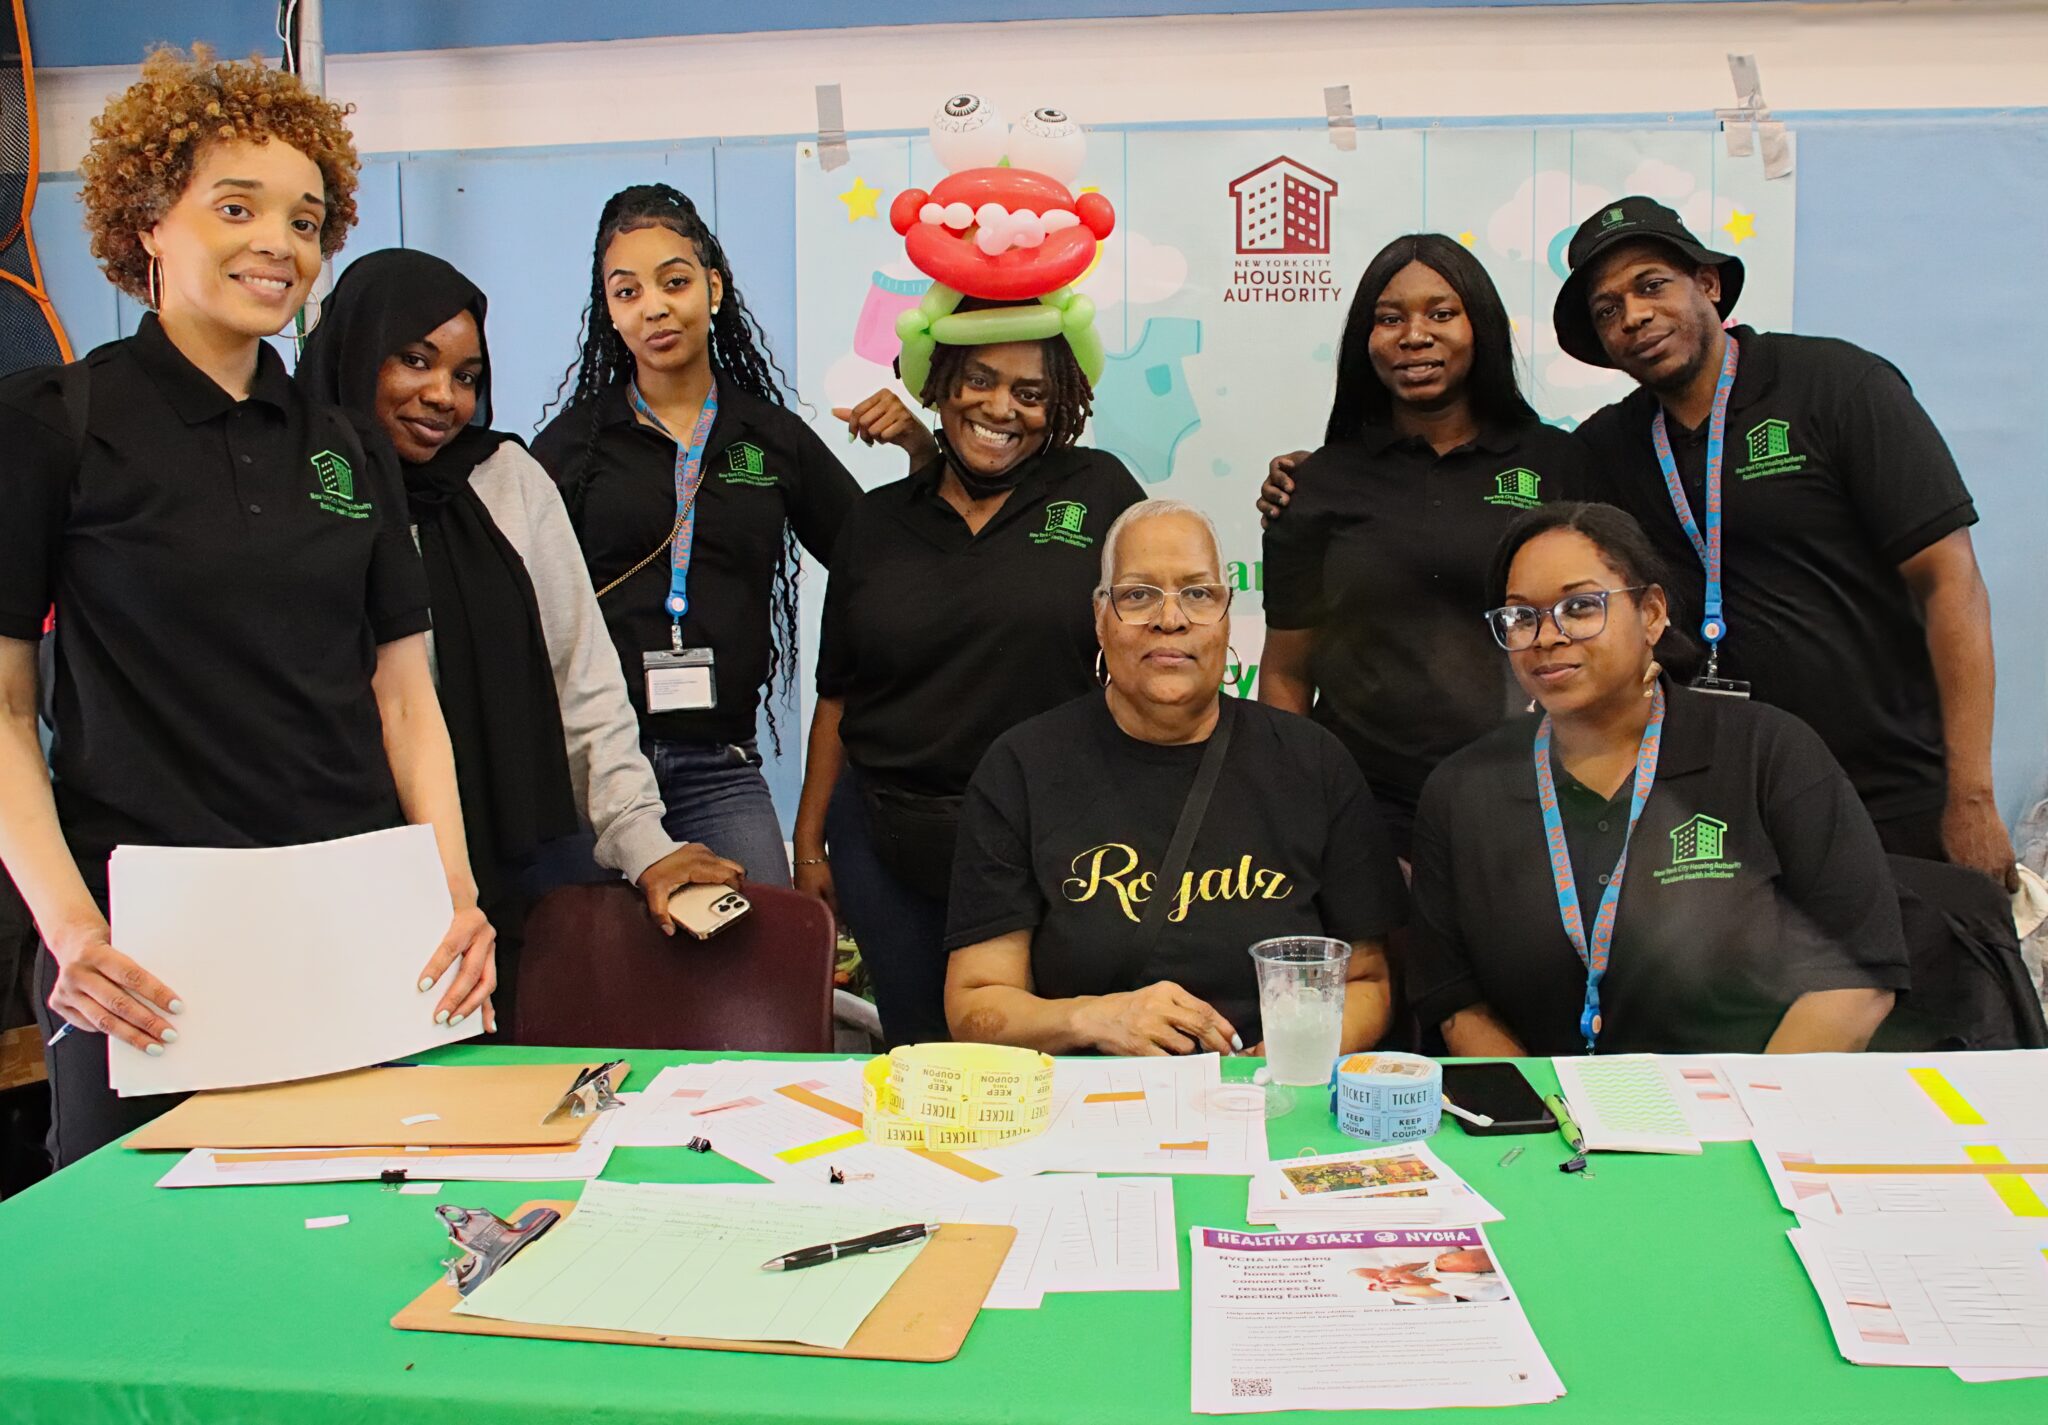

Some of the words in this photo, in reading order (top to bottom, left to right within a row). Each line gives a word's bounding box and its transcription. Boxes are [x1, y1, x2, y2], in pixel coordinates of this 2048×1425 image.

[1235, 259, 1261, 267] NEW
[1266, 259, 1298, 267] YORK
[1303, 259, 1331, 267] CITY
[1234, 270, 1332, 285] HOUSING
[1223, 288, 1341, 302] AUTHORITY
[1711, 385, 1732, 440] NYCHA
[694, 408, 715, 446] NYCHA
[1708, 455, 1722, 513] NYCHA
[1667, 471, 1690, 525] NYCHA
[675, 519, 692, 570] NYCHA
[1709, 526, 1721, 582] NYCHA
[1636, 735, 1659, 801] NYCHA
[1536, 749, 1557, 812] NYCHA
[1548, 826, 1574, 892] NYCHA
[1592, 901, 1617, 971] NYCHA
[923, 1069, 961, 1080] COUPON
[981, 1075, 1020, 1083] COUPON
[928, 1084, 952, 1093] KEEP
[1342, 1084, 1371, 1104] TICKET
[1392, 1090, 1428, 1106] TICKET
[921, 1102, 956, 1119] TICKET
[979, 1109, 1015, 1122] TICKET
[1346, 1112, 1365, 1122] KEEP
[1342, 1122, 1371, 1137] COUPON
[1399, 1117, 1422, 1126] KEEP
[887, 1128, 924, 1141] TICKET
[940, 1131, 978, 1144] TICKET
[1392, 1128, 1427, 1138] COUPON
[1217, 1232, 1301, 1247] HEALTHY
[1305, 1232, 1365, 1245] START
[1405, 1231, 1471, 1243] NYCHA
